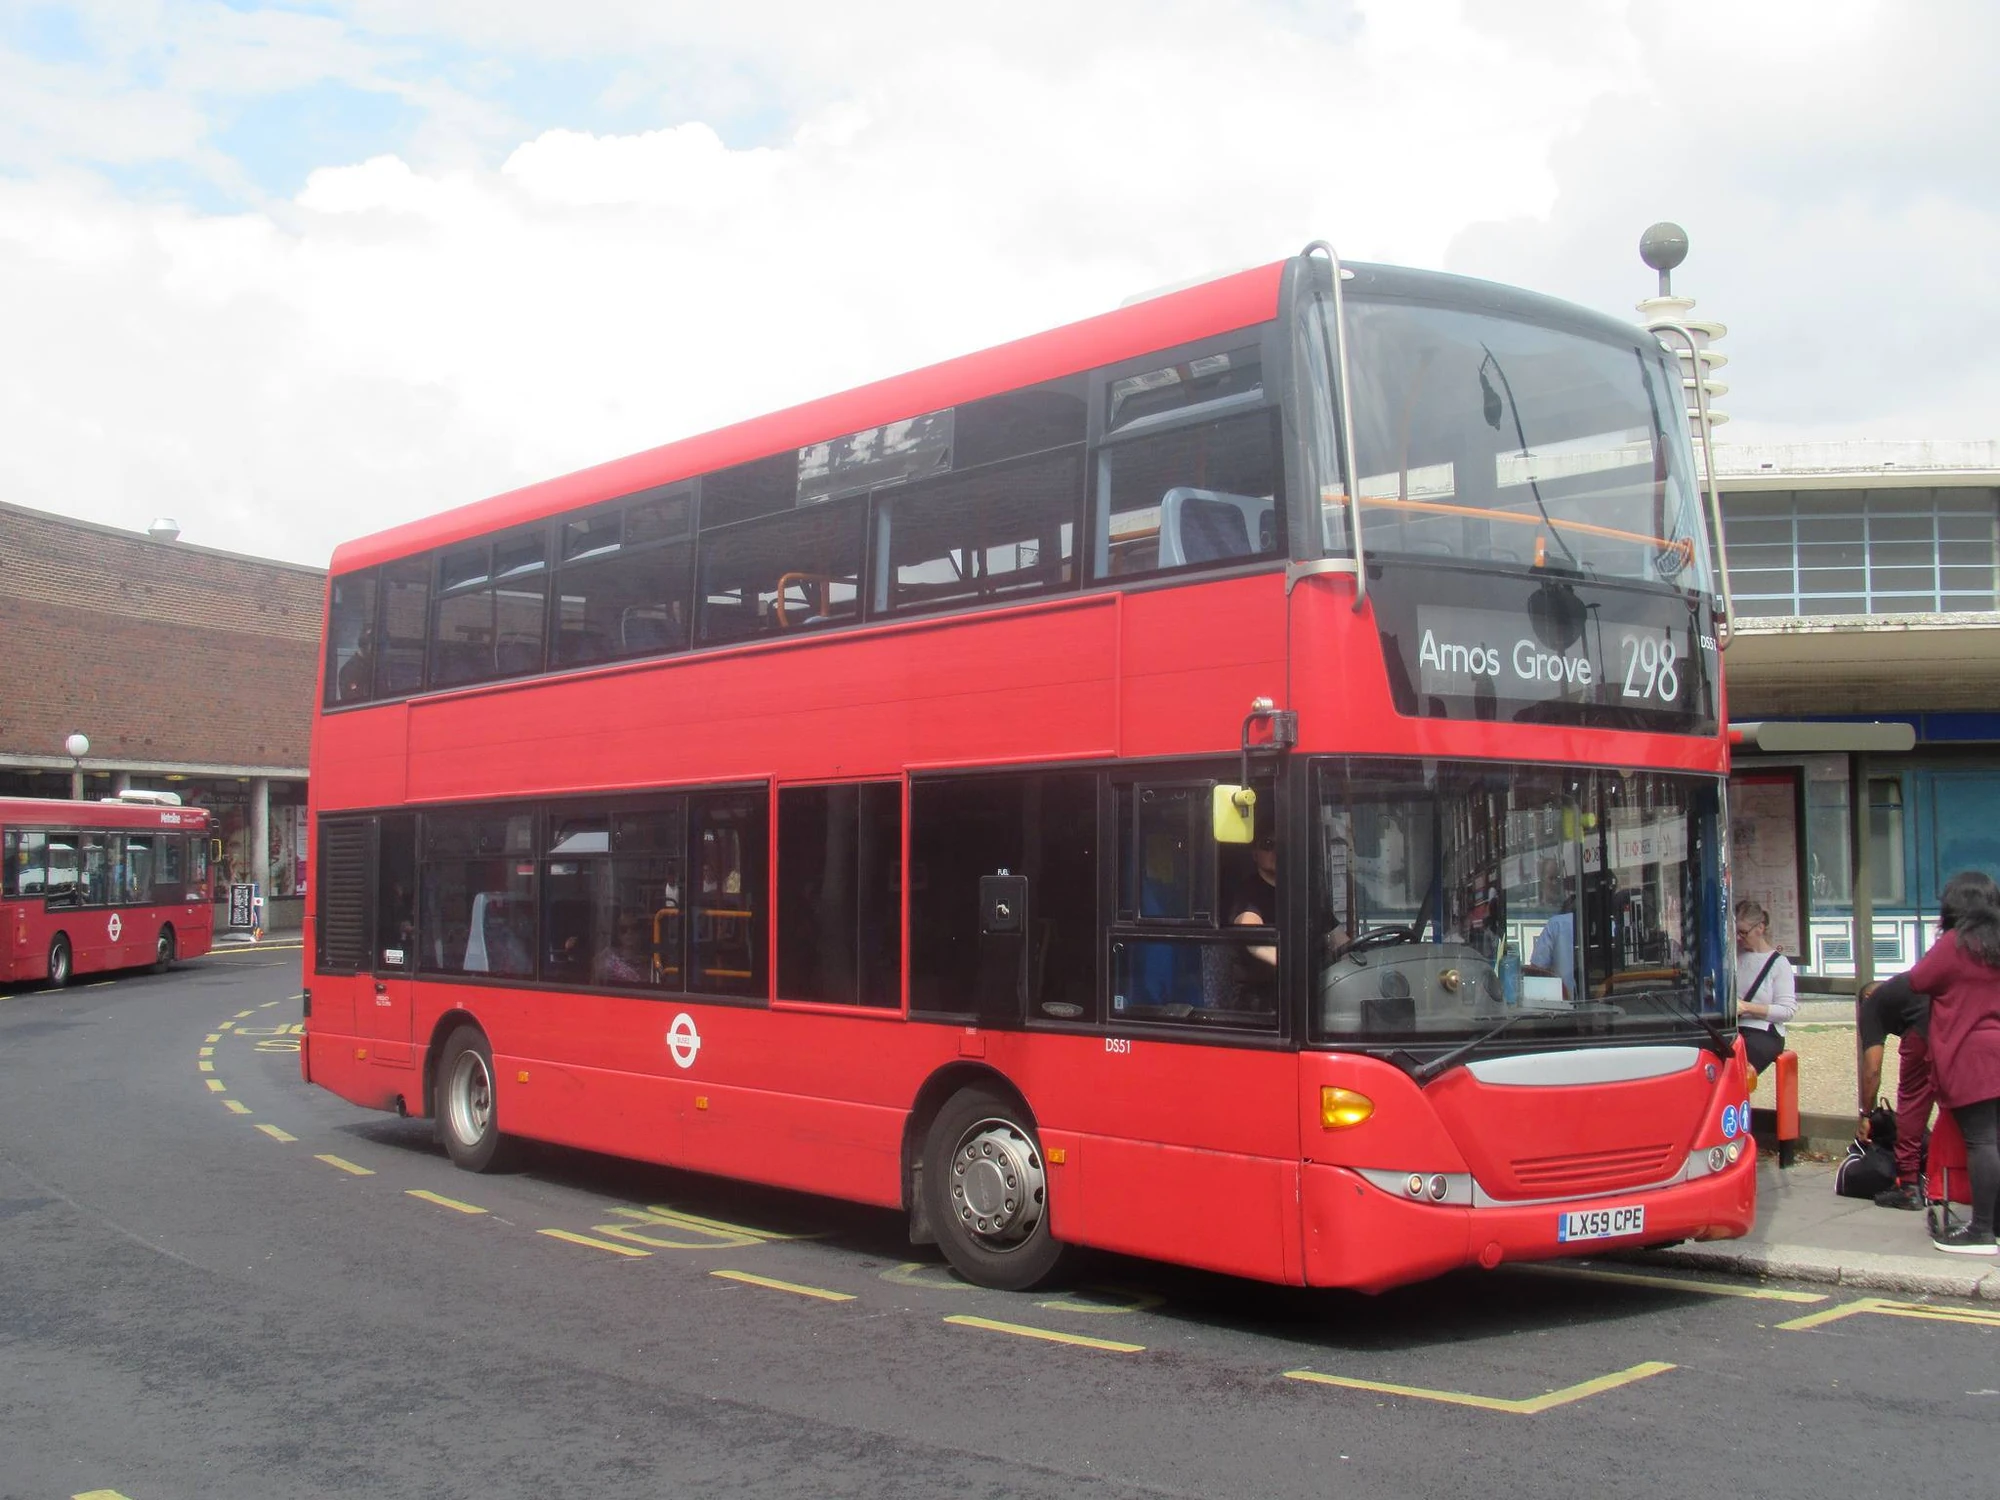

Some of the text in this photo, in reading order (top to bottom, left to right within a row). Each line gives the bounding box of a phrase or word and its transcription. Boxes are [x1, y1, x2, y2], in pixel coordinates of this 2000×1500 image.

[1700, 635, 1717, 651] DS51
[1419, 629, 1678, 701] Arnos Grove 298
[1105, 1037, 1131, 1054] DS51
[1569, 1207, 1642, 1236] LX59 CPE
